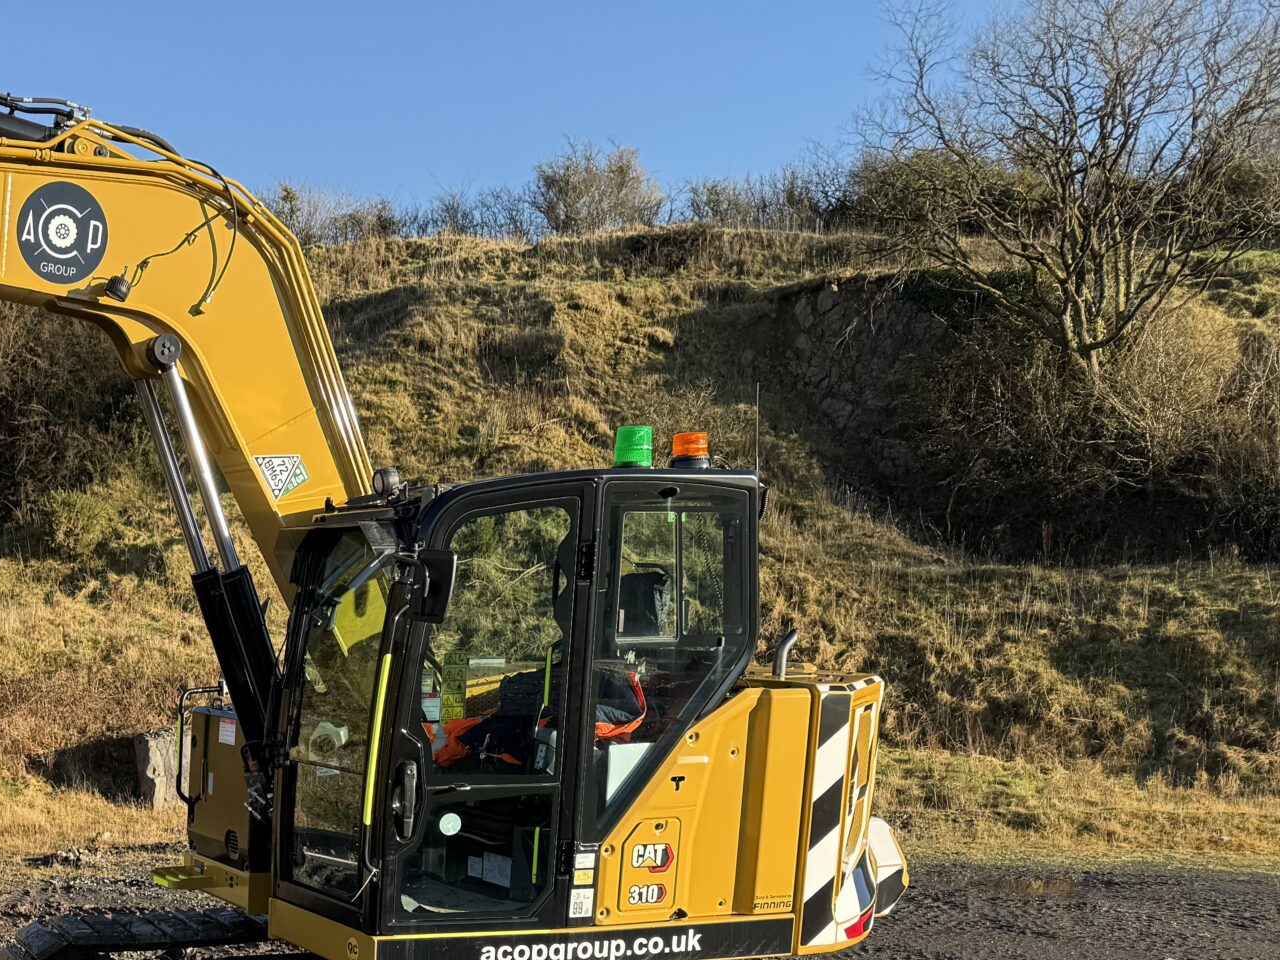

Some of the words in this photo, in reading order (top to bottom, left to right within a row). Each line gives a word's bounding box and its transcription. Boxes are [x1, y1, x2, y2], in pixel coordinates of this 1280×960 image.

[40, 262, 77, 277] GROUP
[276, 460, 289, 476] 72
[632, 844, 666, 868] CAT
[629, 884, 658, 904] 310
[572, 901, 583, 914] 99
[753, 901, 792, 910] FINNING
